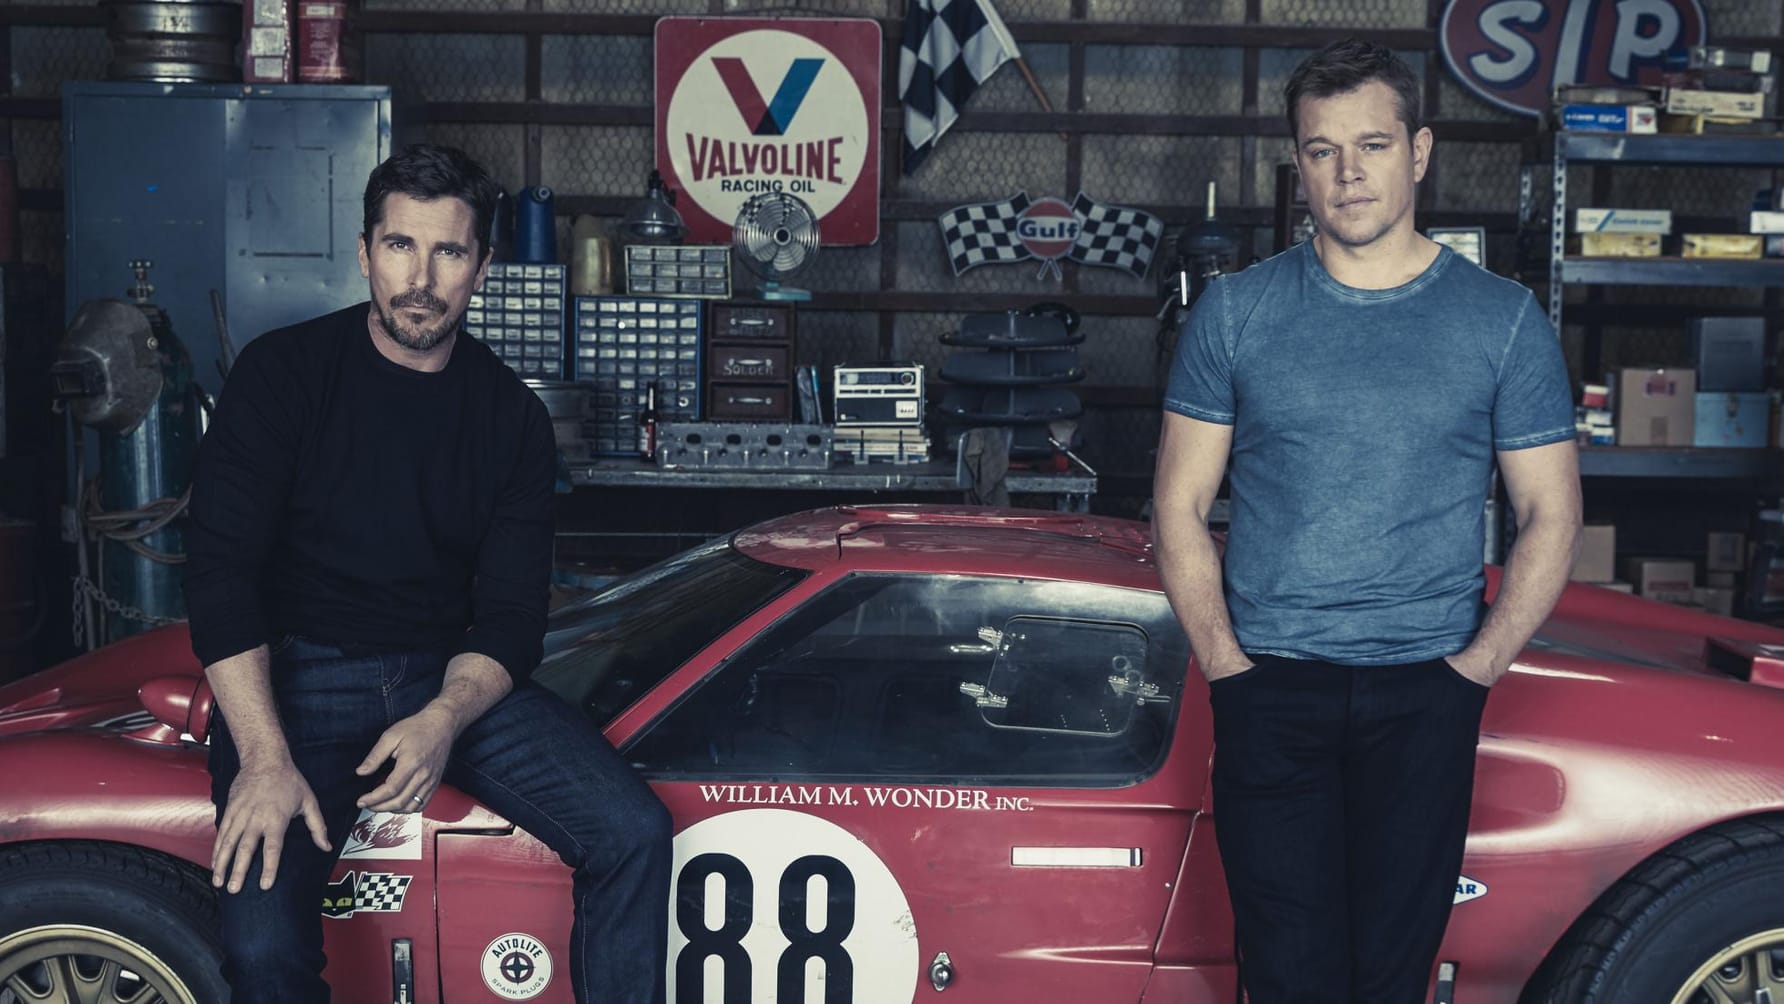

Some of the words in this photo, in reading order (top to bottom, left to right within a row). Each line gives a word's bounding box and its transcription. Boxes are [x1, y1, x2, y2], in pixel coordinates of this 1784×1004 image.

[686, 132, 844, 185] VALVOLINE
[721, 179, 783, 193] RACING
[790, 180, 816, 193] OIL
[1018, 219, 1078, 238] Gulf
[722, 364, 774, 376] SOLDER
[699, 785, 822, 805] WILLIAM
[827, 787, 859, 806] M.
[863, 787, 990, 810] WONDER
[995, 796, 1034, 812] INC.
[1456, 884, 1476, 894] AR
[676, 852, 856, 1004] 88
[492, 938, 543, 958] AUTOLITE
[492, 978, 518, 995] SPARK
[520, 976, 545, 995] PLUGS
